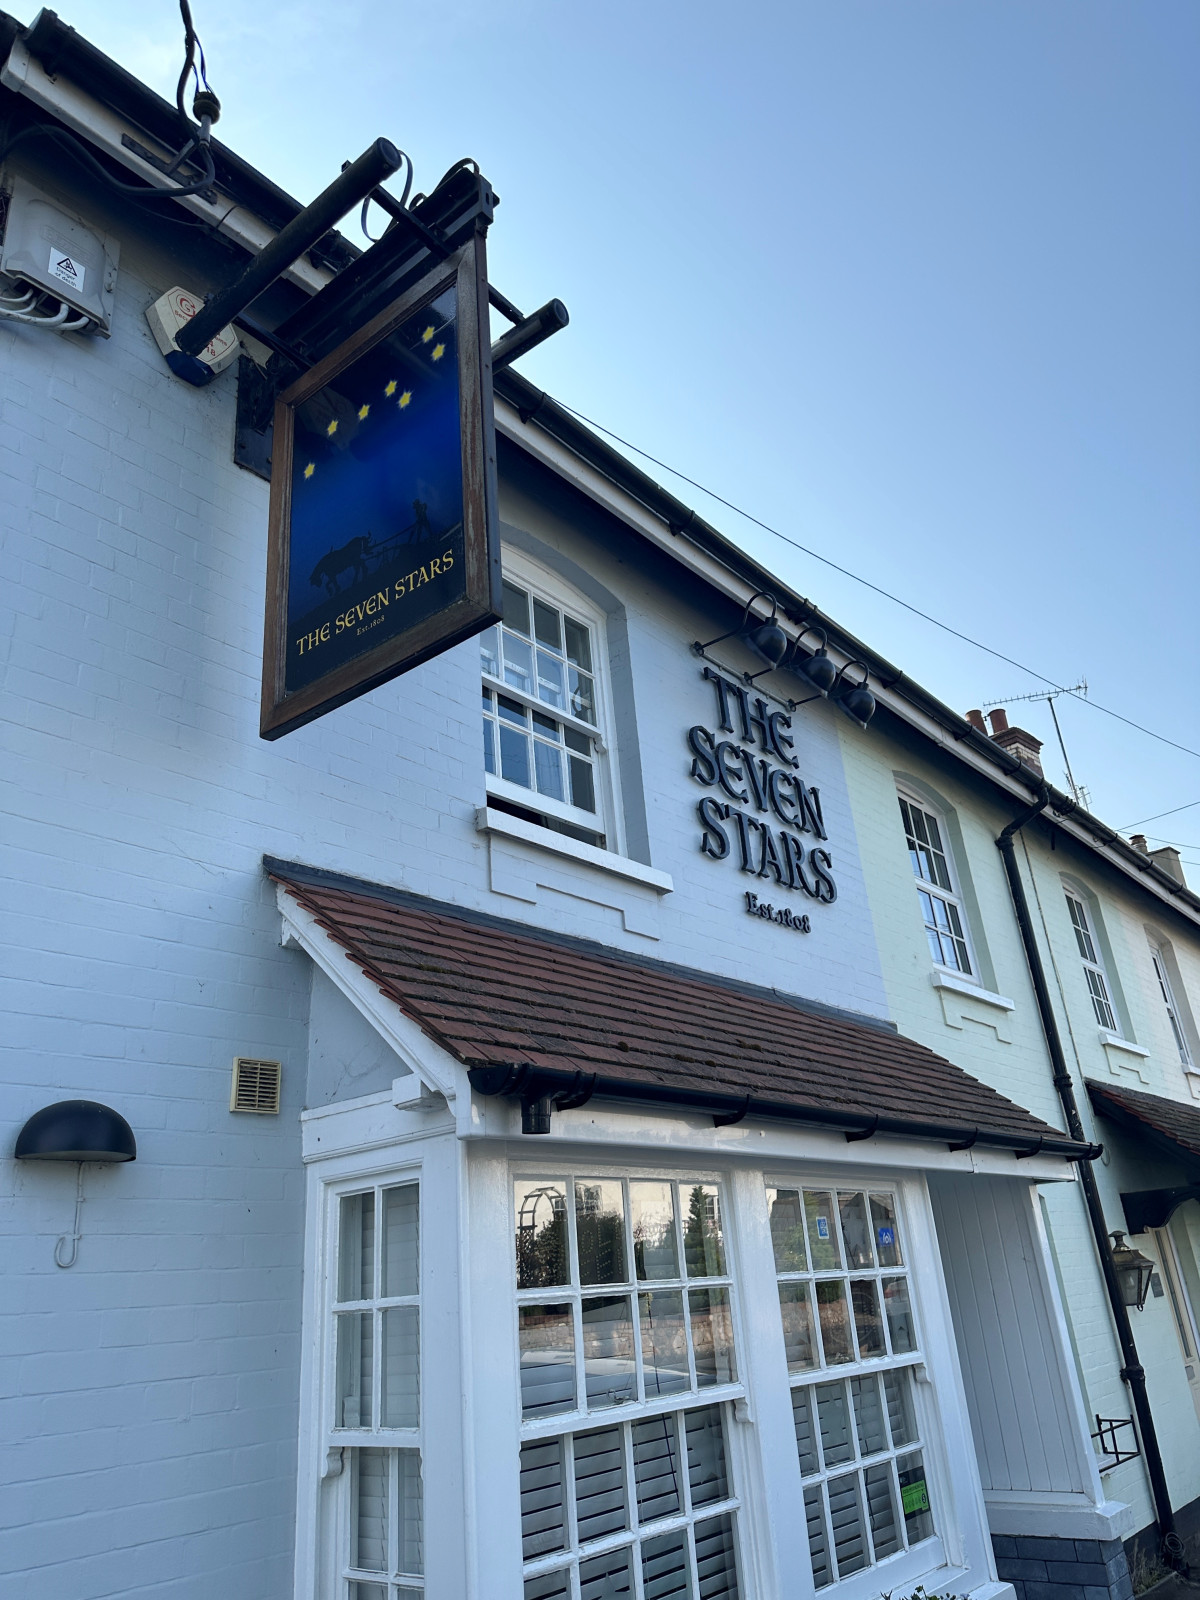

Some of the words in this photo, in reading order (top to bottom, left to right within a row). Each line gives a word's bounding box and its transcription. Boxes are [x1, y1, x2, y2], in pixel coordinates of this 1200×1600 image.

[296, 622, 331, 656] THE
[335, 587, 390, 635] SEVEN
[394, 548, 455, 600] STARS
[356, 614, 386, 637] Est.1808
[703, 666, 800, 769] THE
[687, 725, 829, 841] SEVEN
[699, 796, 838, 904] STARS
[745, 891, 811, 934] Est.1808
